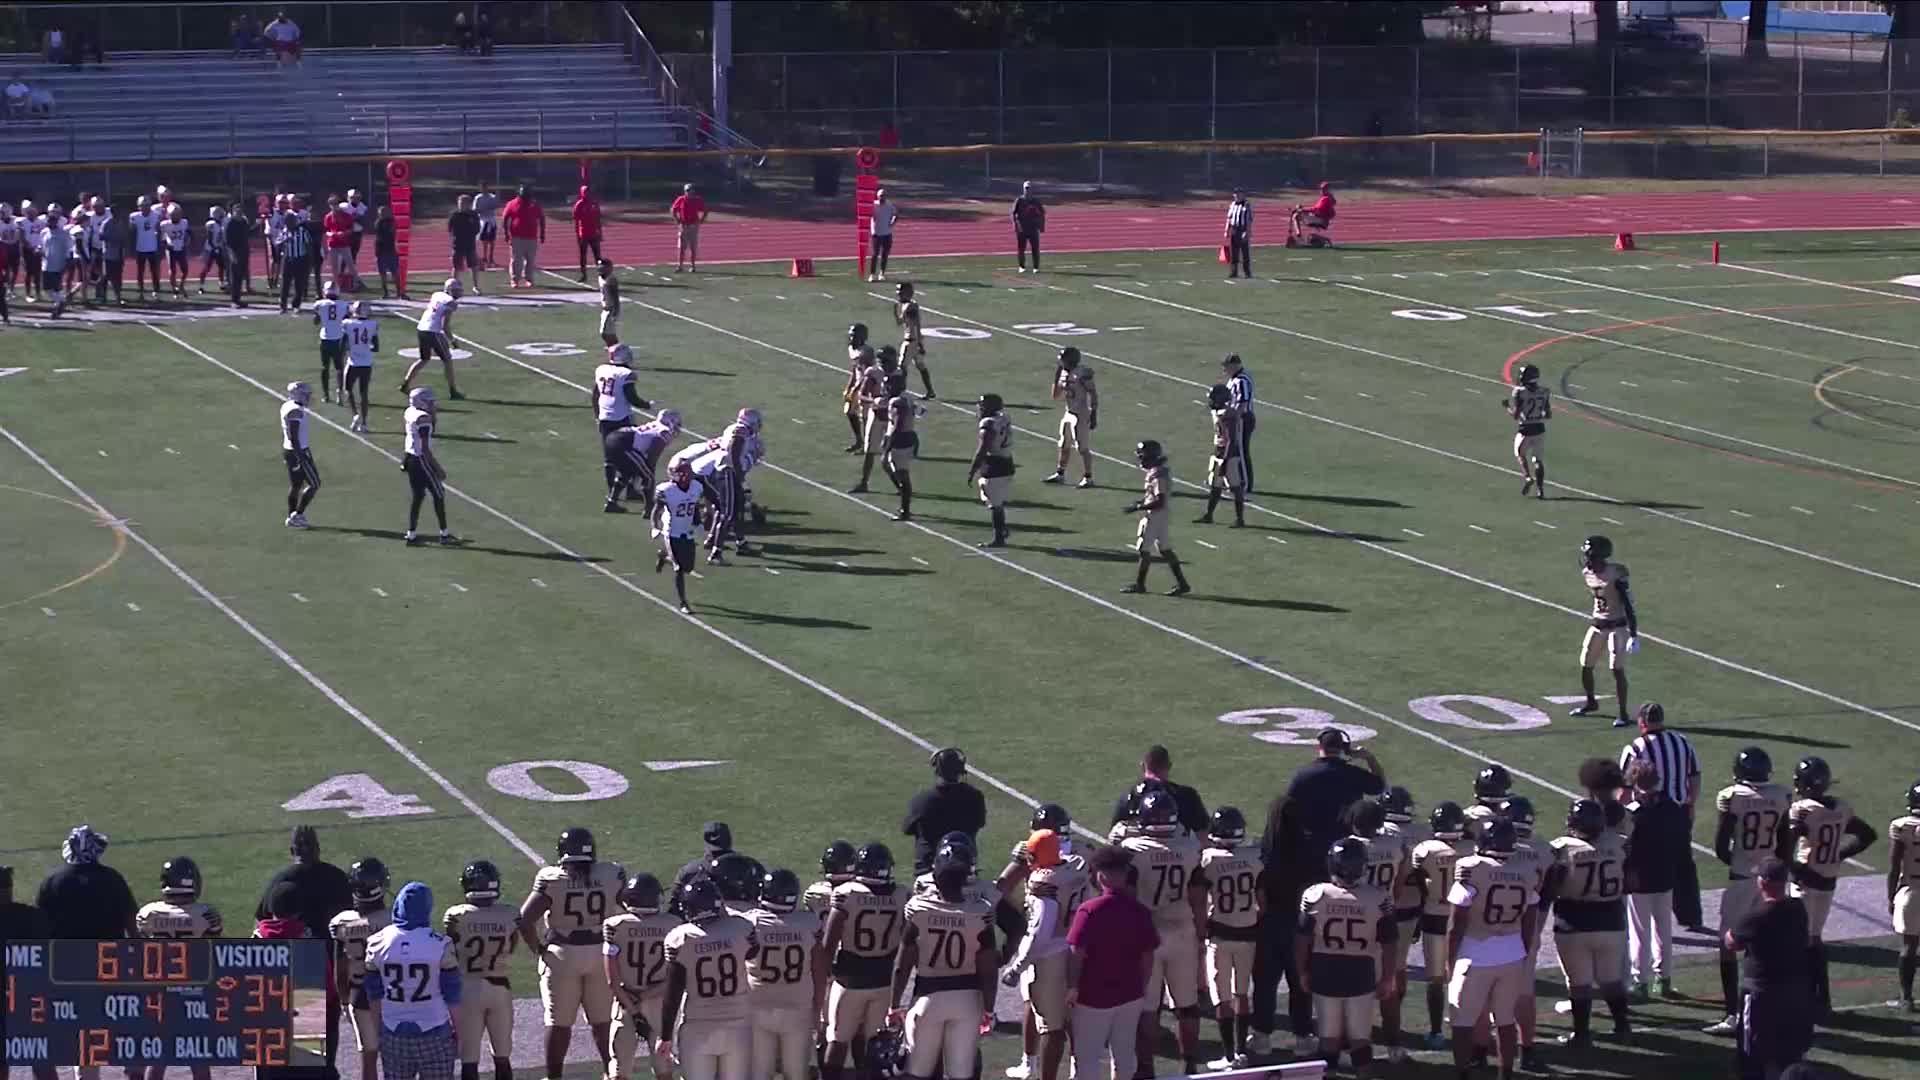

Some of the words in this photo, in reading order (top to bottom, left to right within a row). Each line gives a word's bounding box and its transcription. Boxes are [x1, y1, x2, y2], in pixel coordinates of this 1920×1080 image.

[353, 327, 369, 345] 14
[282, 760, 630, 819] 40
[1743, 810, 1780, 851] 83
[1815, 823, 1841, 864] 81
[1151, 865, 1184, 907] 79
[1216, 872, 1255, 915] 89
[1574, 860, 1618, 898] 76
[563, 890, 606, 927] 59
[1483, 884, 1527, 925] 63
[853, 909, 897, 952] 67
[927, 928, 966, 969] 70
[1323, 918, 1368, 950] 65
[464, 936, 506, 973] 27
[627, 940, 666, 986] 42
[760, 944, 805, 984] 58
[384, 963, 432, 1002] 32
[695, 953, 738, 998] 68
